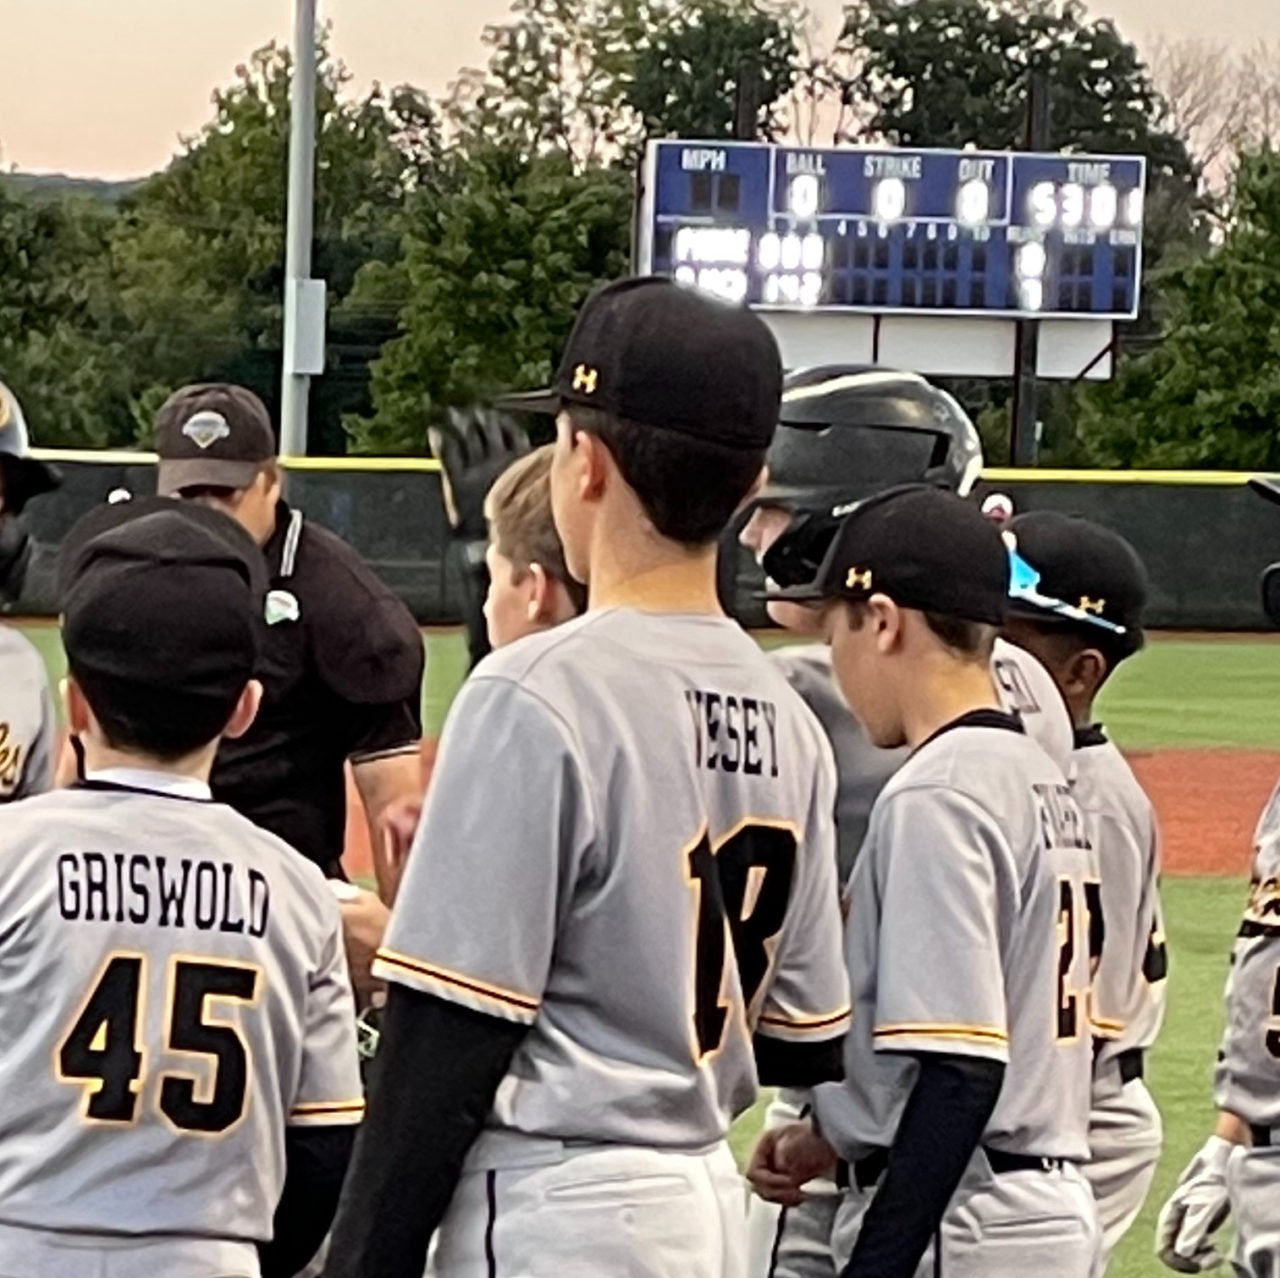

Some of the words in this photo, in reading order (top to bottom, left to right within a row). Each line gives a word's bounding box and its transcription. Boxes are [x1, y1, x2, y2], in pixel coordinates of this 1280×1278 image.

[681, 148, 727, 171] MPH
[785, 152, 826, 175] BALL
[863, 155, 922, 178] STRIKE
[958, 159, 995, 180] OUT
[1067, 163, 1111, 185] TIME
[56, 852, 271, 939] GRISWOLD
[54, 948, 265, 1136] 45
